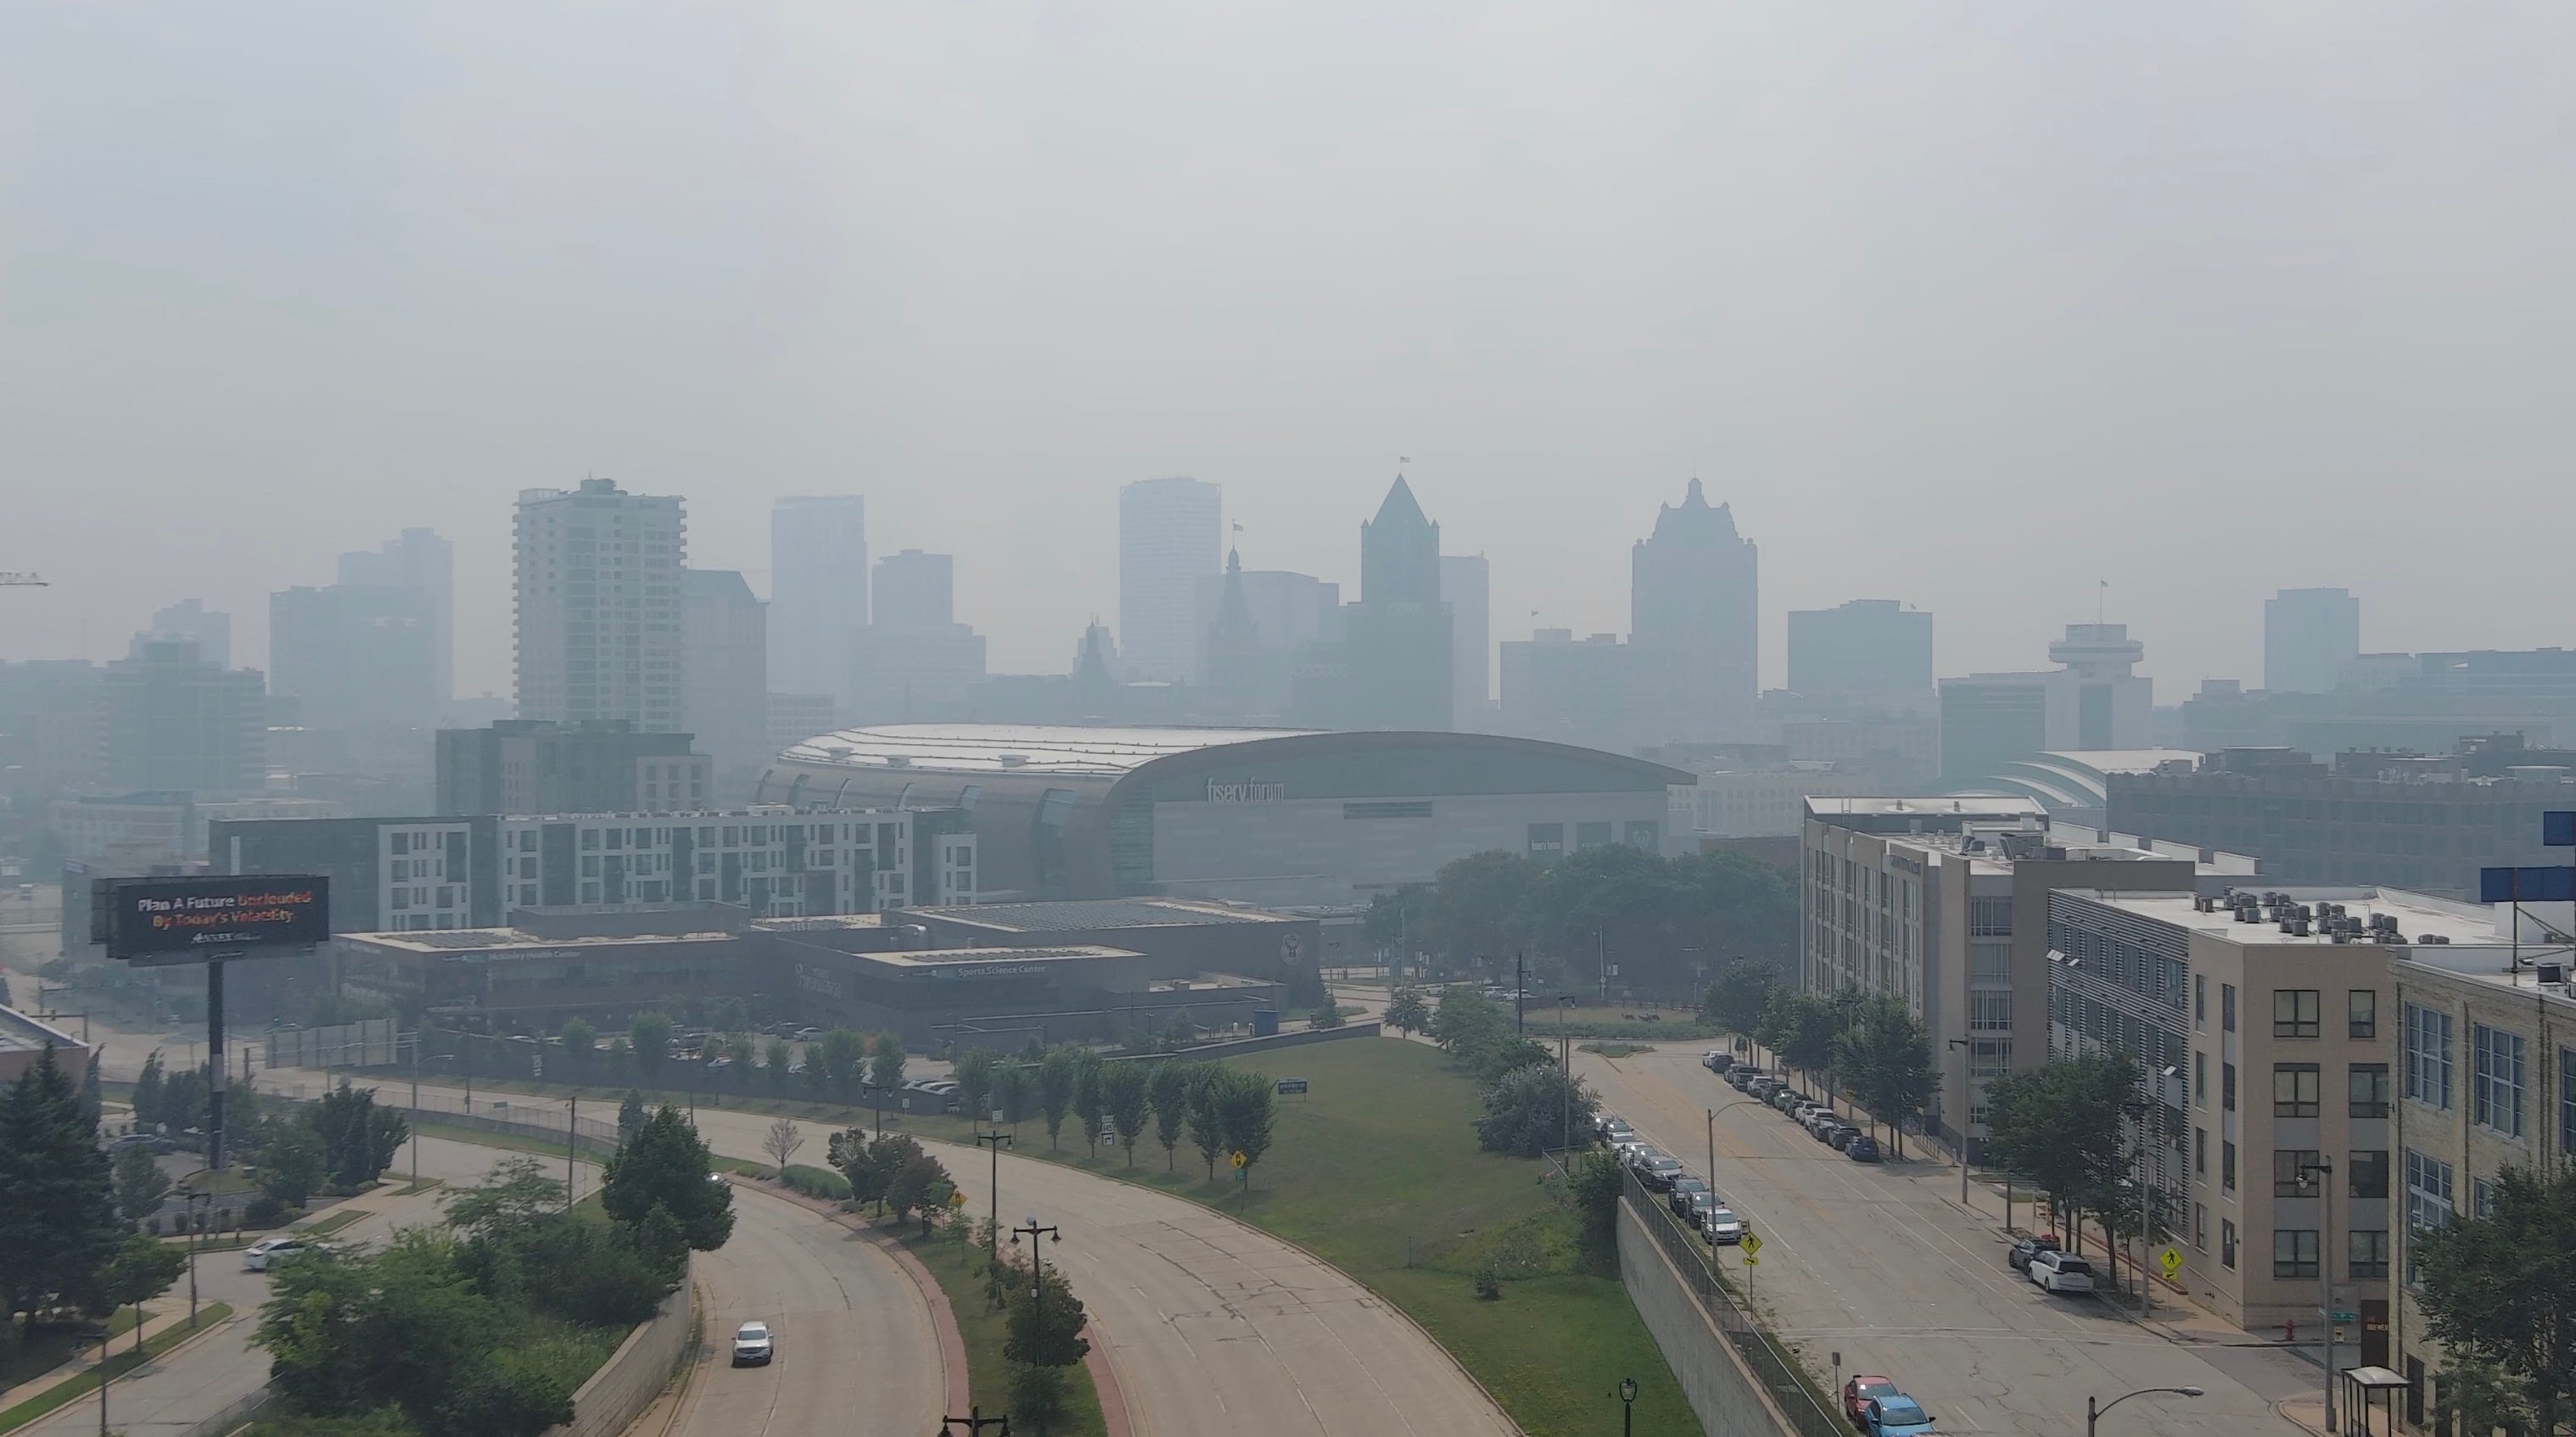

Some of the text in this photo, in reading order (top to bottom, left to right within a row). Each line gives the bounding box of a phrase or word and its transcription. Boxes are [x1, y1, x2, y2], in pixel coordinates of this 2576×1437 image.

[1207, 777, 1283, 802] fiserv forum
[137, 891, 312, 912] Plan A Future Unclouded
[153, 914, 172, 931] By
[174, 911, 227, 928] Today's
[554, 950, 581, 959] Center
[957, 967, 985, 978] Sports
[986, 965, 1018, 976] Science
